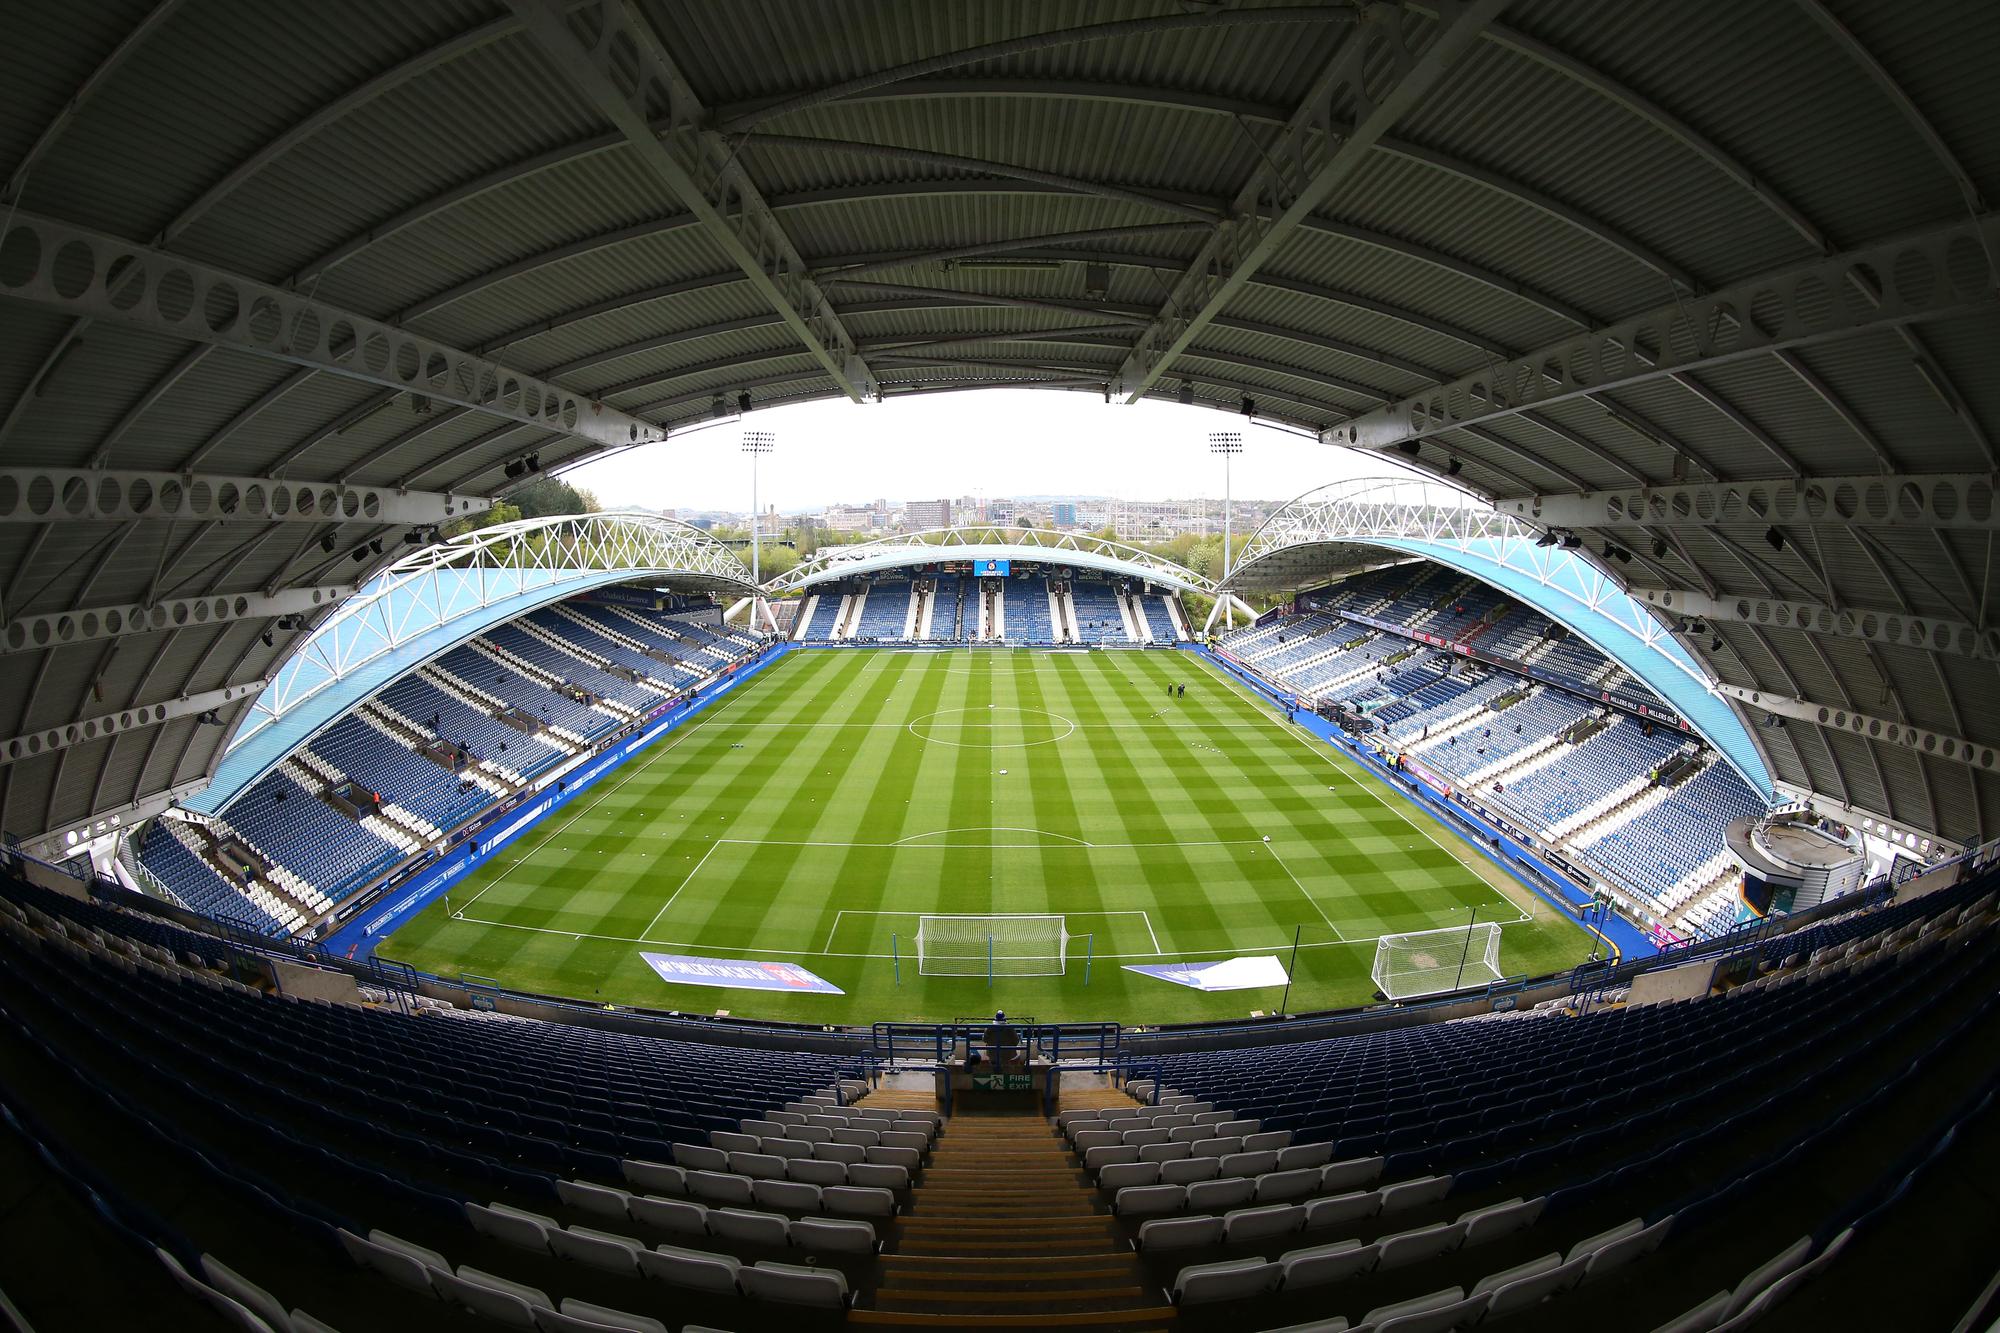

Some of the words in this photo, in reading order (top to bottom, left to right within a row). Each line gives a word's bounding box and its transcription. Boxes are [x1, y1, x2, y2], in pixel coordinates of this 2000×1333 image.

[1610, 695, 1628, 707] MILLERS
[1627, 701, 1637, 710] OILS
[1648, 709, 1667, 721] MILLERS
[1667, 715, 1678, 725] OILS
[1009, 1074, 1031, 1082] FIRE
